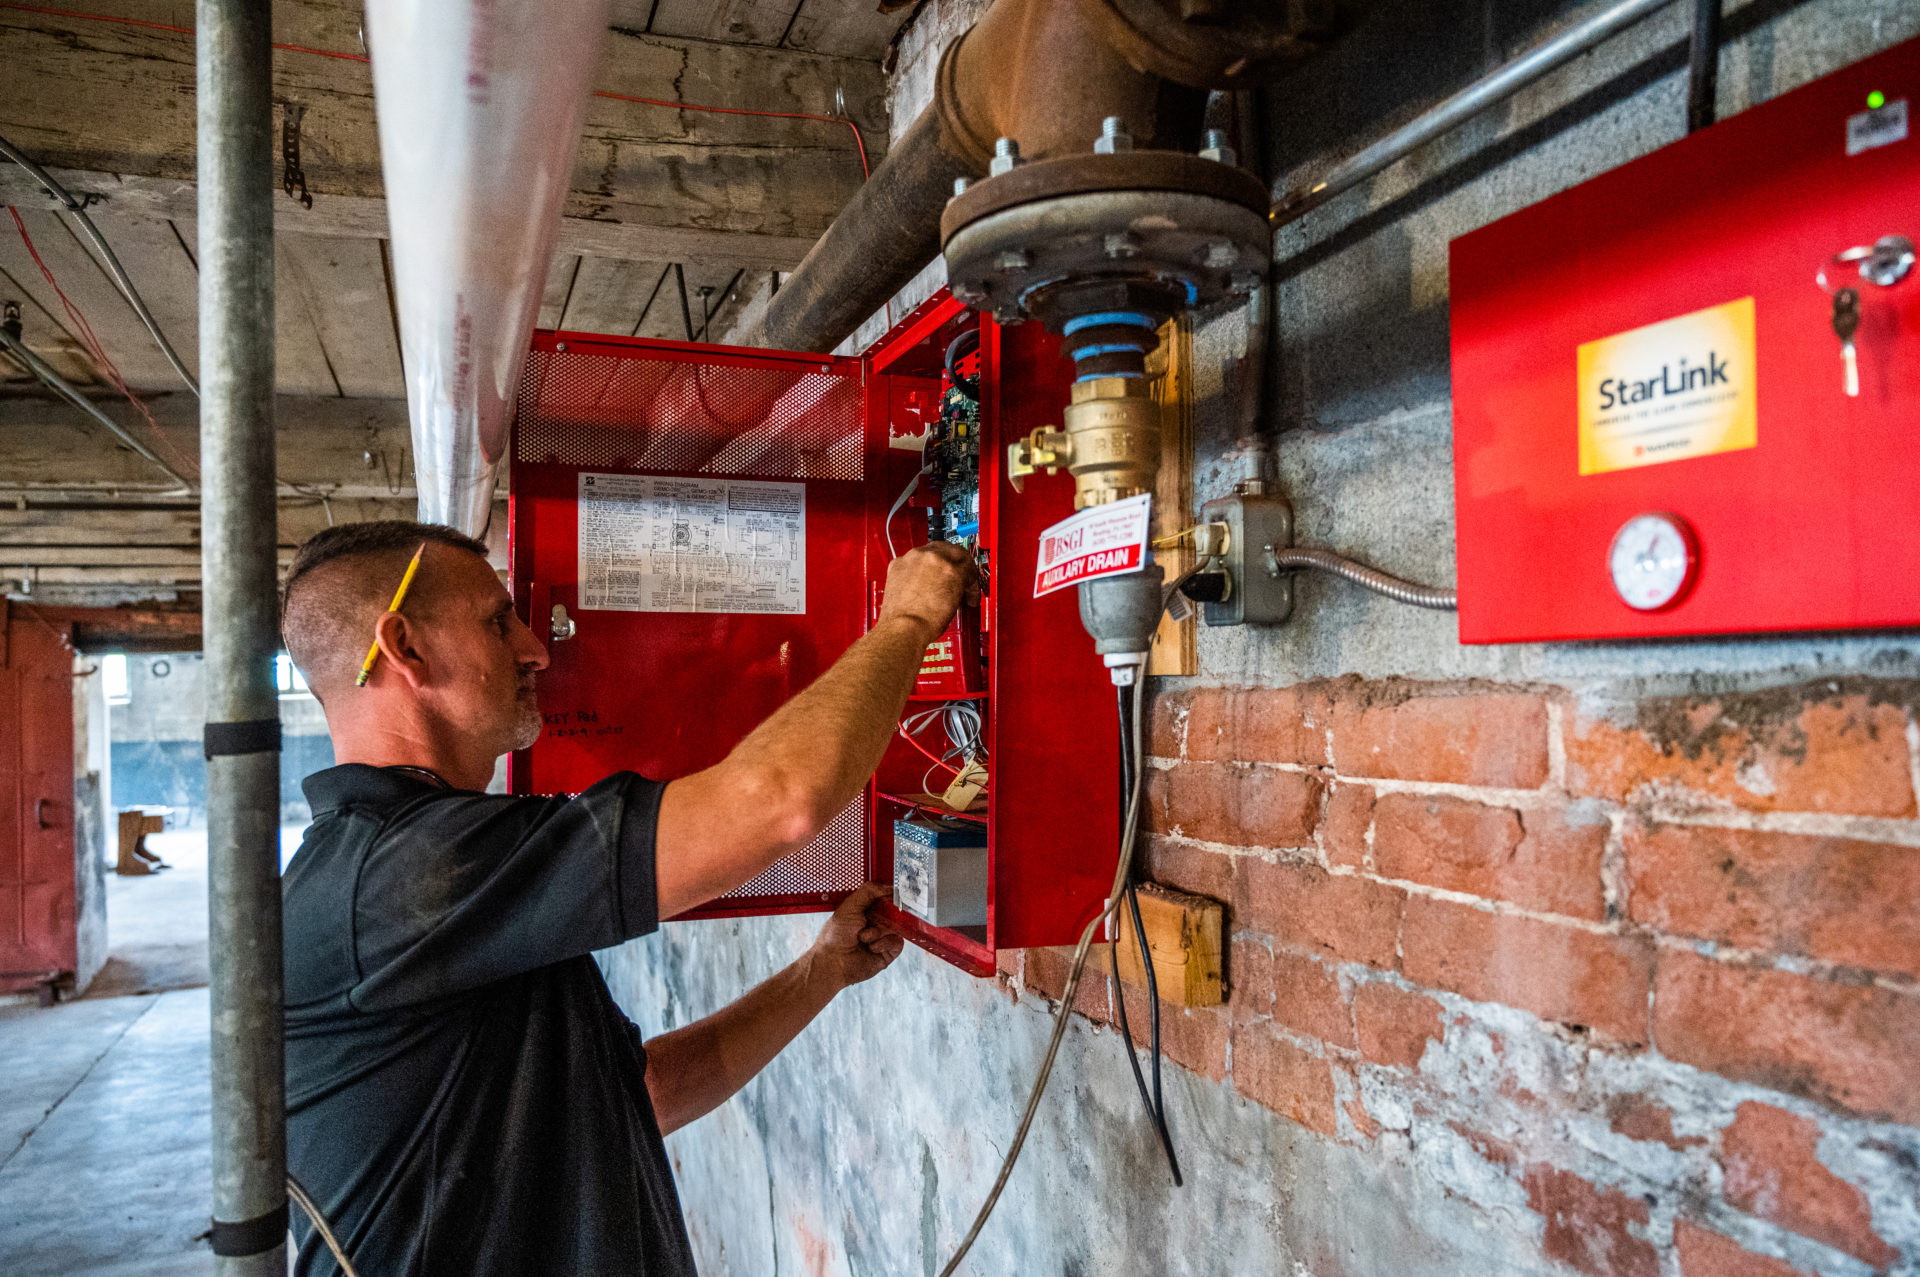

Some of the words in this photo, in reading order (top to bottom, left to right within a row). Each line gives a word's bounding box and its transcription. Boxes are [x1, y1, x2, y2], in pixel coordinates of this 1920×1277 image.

[1599, 351, 1728, 410] StarLink
[1042, 558, 1086, 588] AUXILARY
[1087, 548, 1129, 573] DRAIN
[544, 712, 569, 724] KEY
[577, 709, 598, 722] Pad
